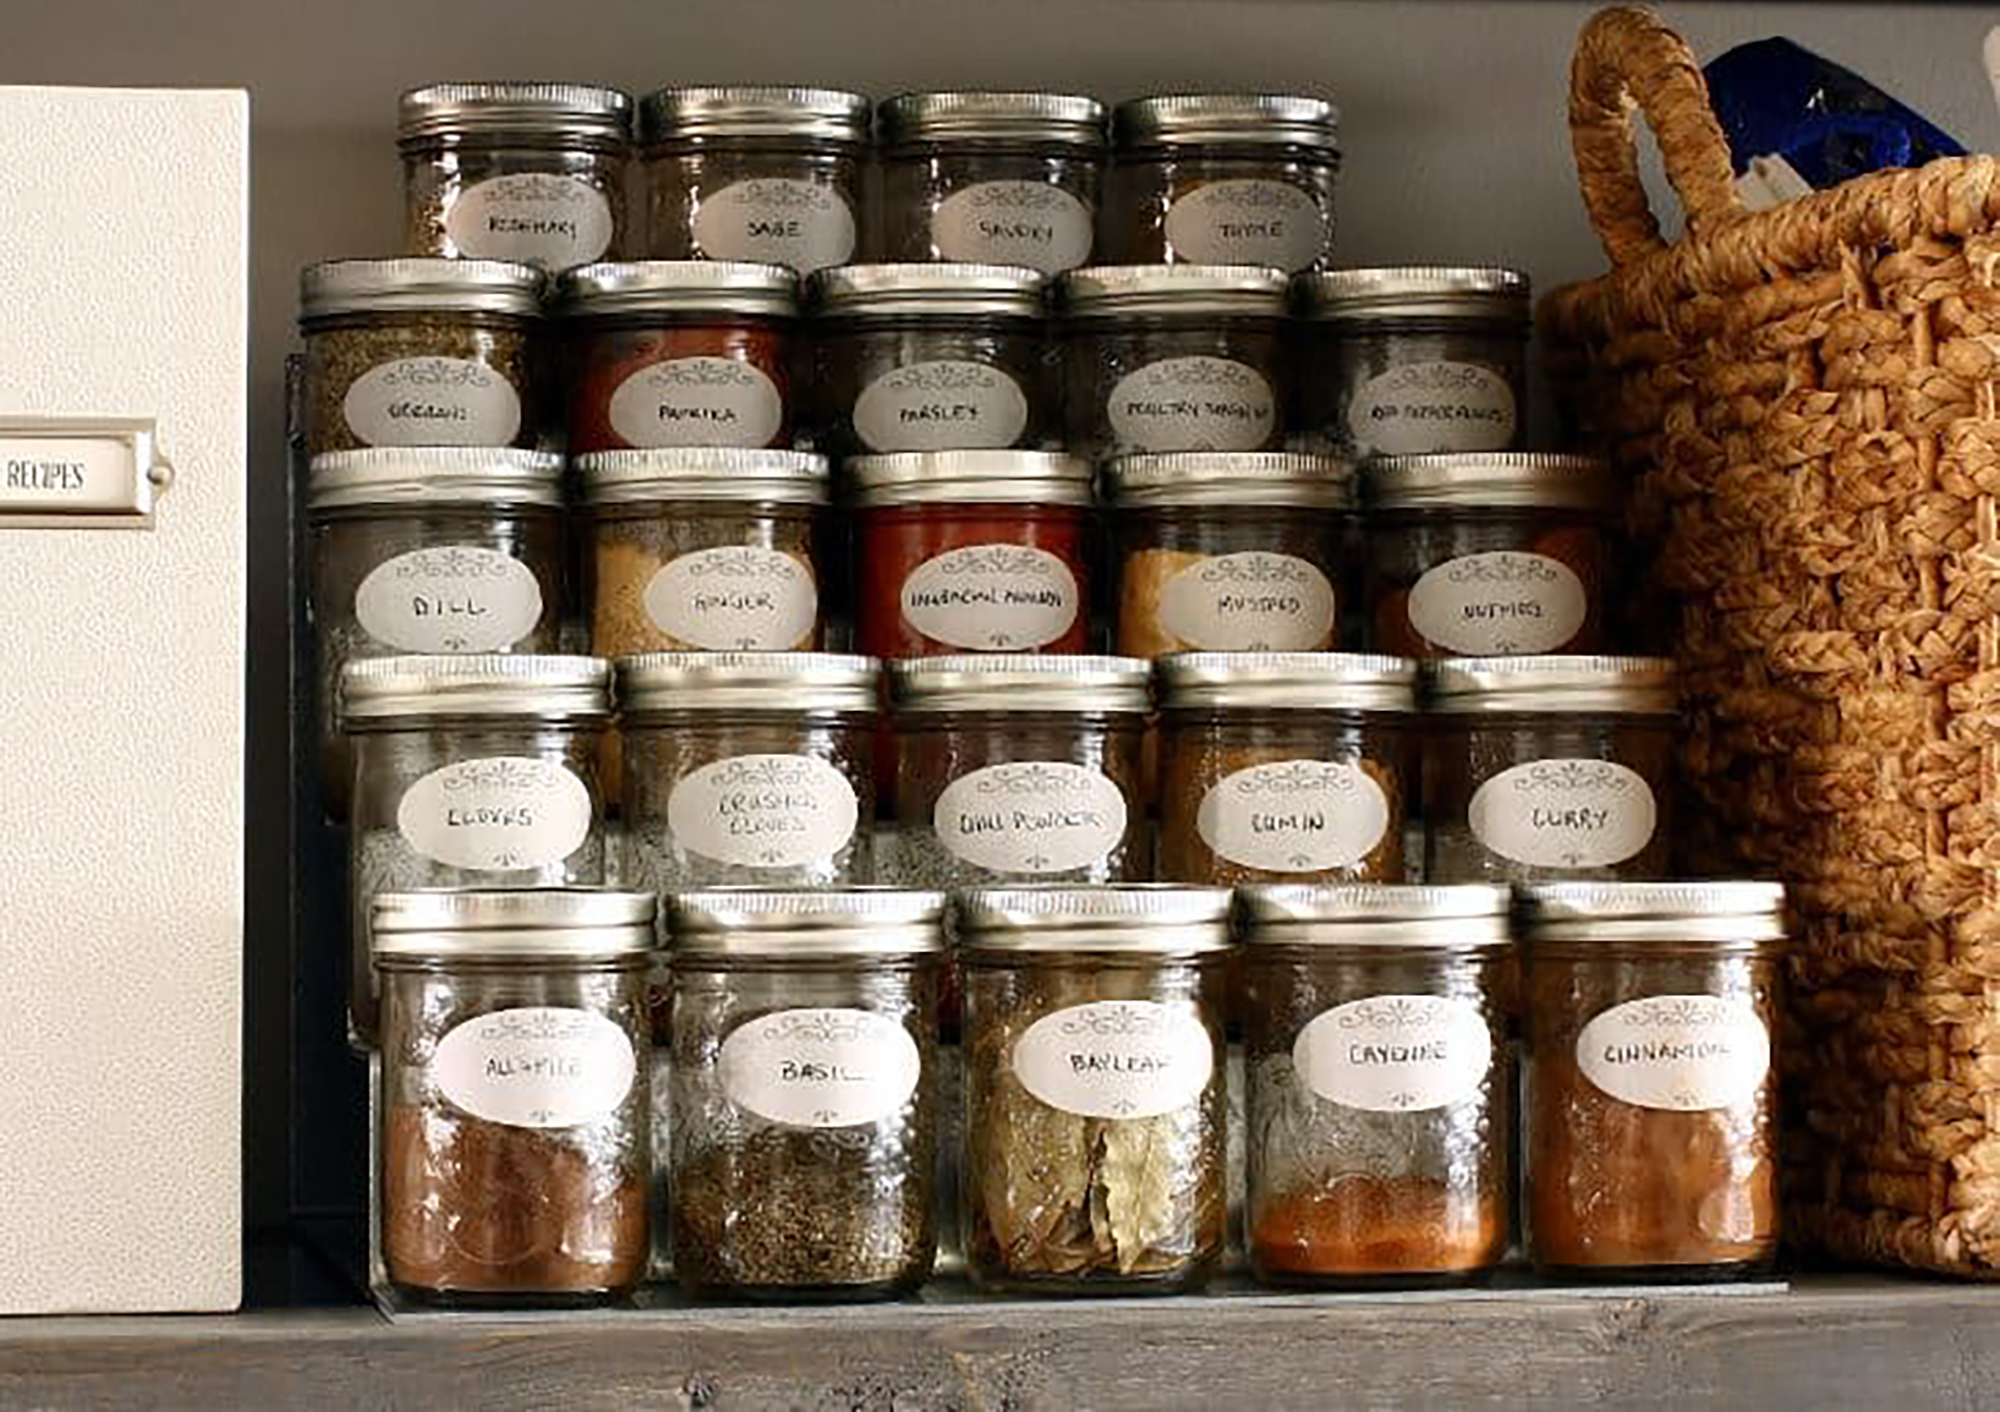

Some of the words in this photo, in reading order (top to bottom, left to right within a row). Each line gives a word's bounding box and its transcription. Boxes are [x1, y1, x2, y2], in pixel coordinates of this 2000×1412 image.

[900, 404, 978, 422] PARSLEY
[7, 460, 84, 489] RECIPES
[413, 596, 487, 616] DILL
[1252, 812, 1324, 833] CUMIN
[1533, 807, 1608, 830] CURRY
[780, 1060, 868, 1081] BASIL
